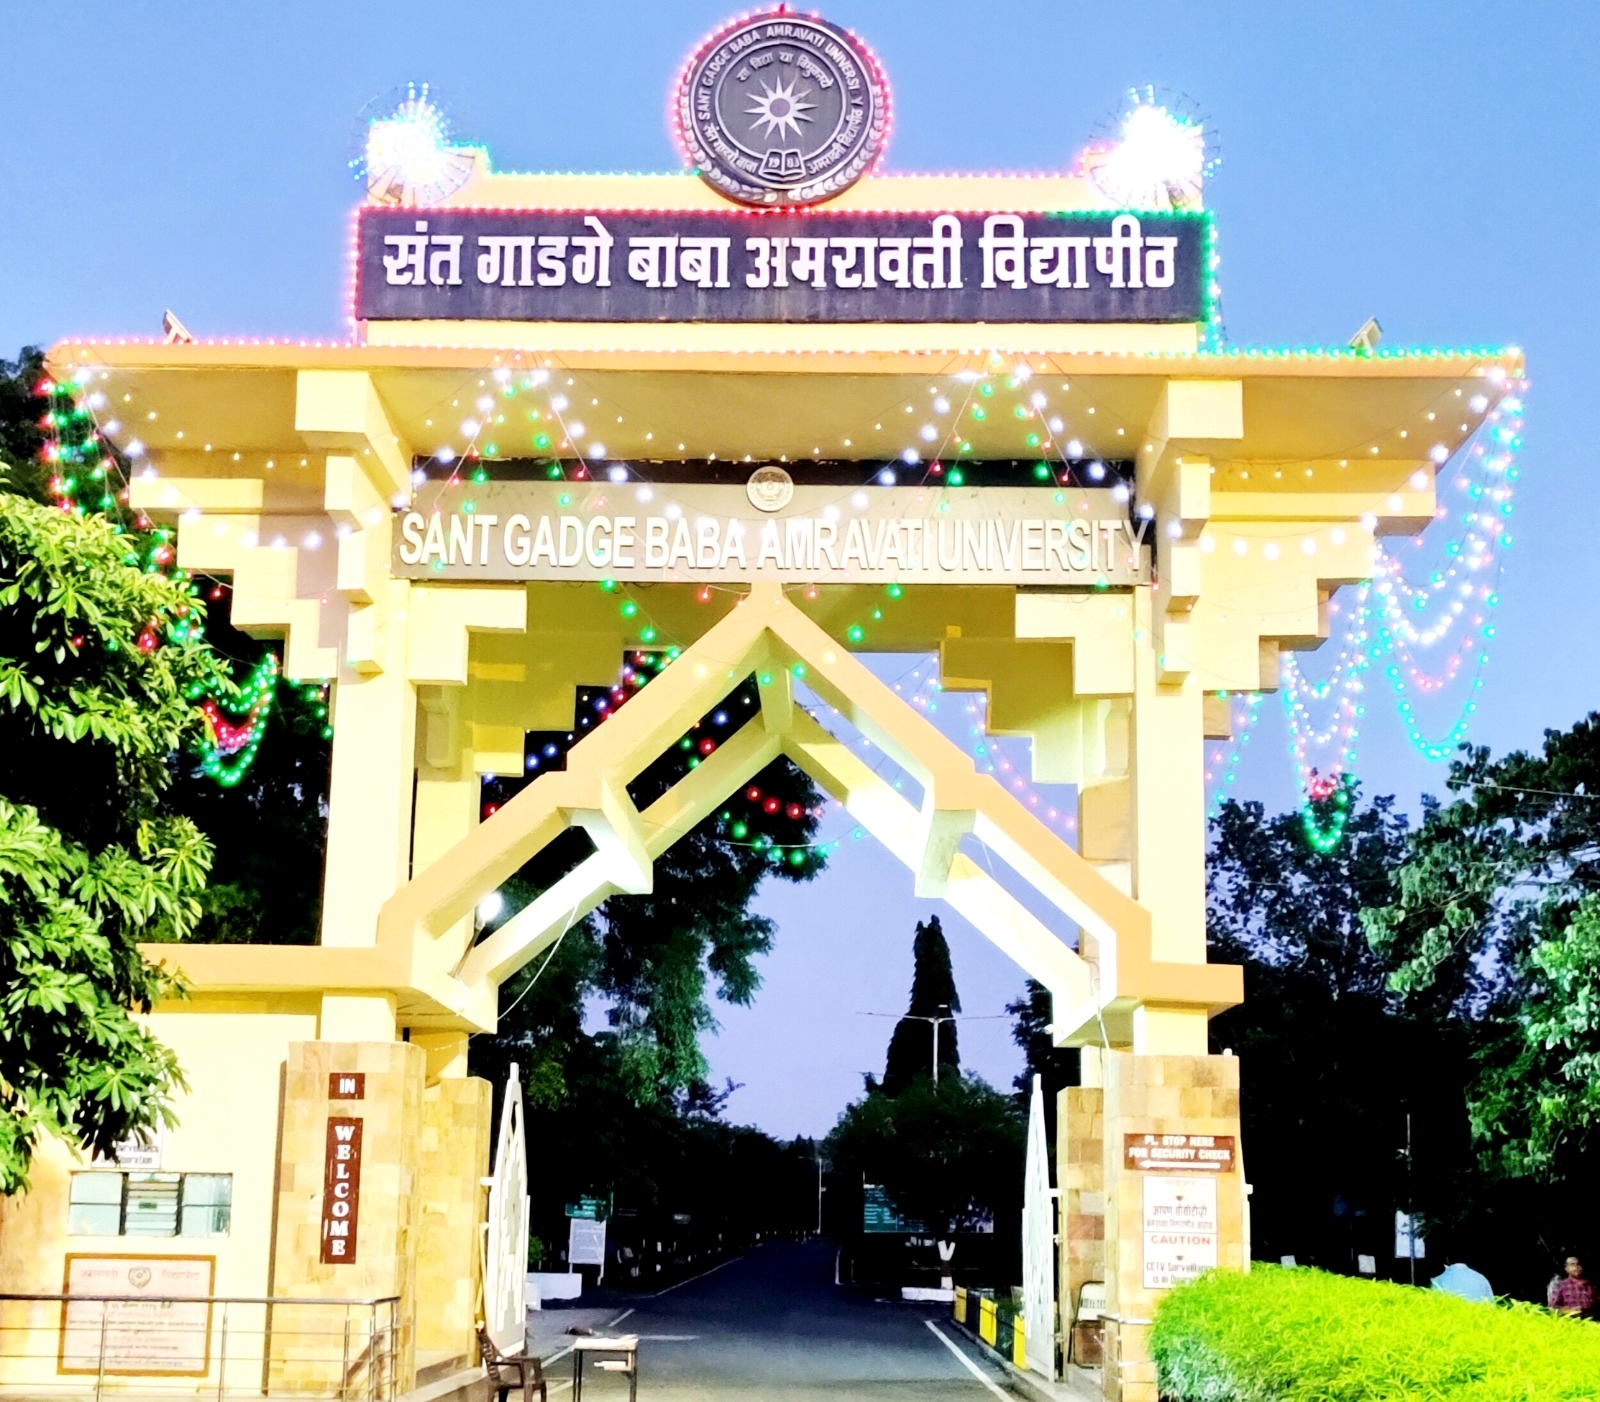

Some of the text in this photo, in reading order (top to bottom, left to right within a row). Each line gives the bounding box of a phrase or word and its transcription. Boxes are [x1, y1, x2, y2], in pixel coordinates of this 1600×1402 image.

[729, 30, 761, 53] BABA
[766, 25, 826, 47] AMRAVATI
[702, 49, 731, 87] GADGE
[697, 87, 711, 120] SANT
[383, 214, 1178, 289] संत गाडगे बाबा अमरावती विद्यापीठ
[399, 512, 1150, 572] SANT GADGE BABA AMRAVATI UNIVERSITY
[339, 1078, 356, 1094] IN
[1162, 1136, 1186, 1146] STOP
[1189, 1136, 1215, 1147] HERE
[1129, 1147, 1231, 1160] FOR SECURITY CHECK
[329, 1126, 355, 1256] WELCOME
[1150, 1234, 1211, 1246] CAUTION
[1146, 1261, 1165, 1271] CCTV
